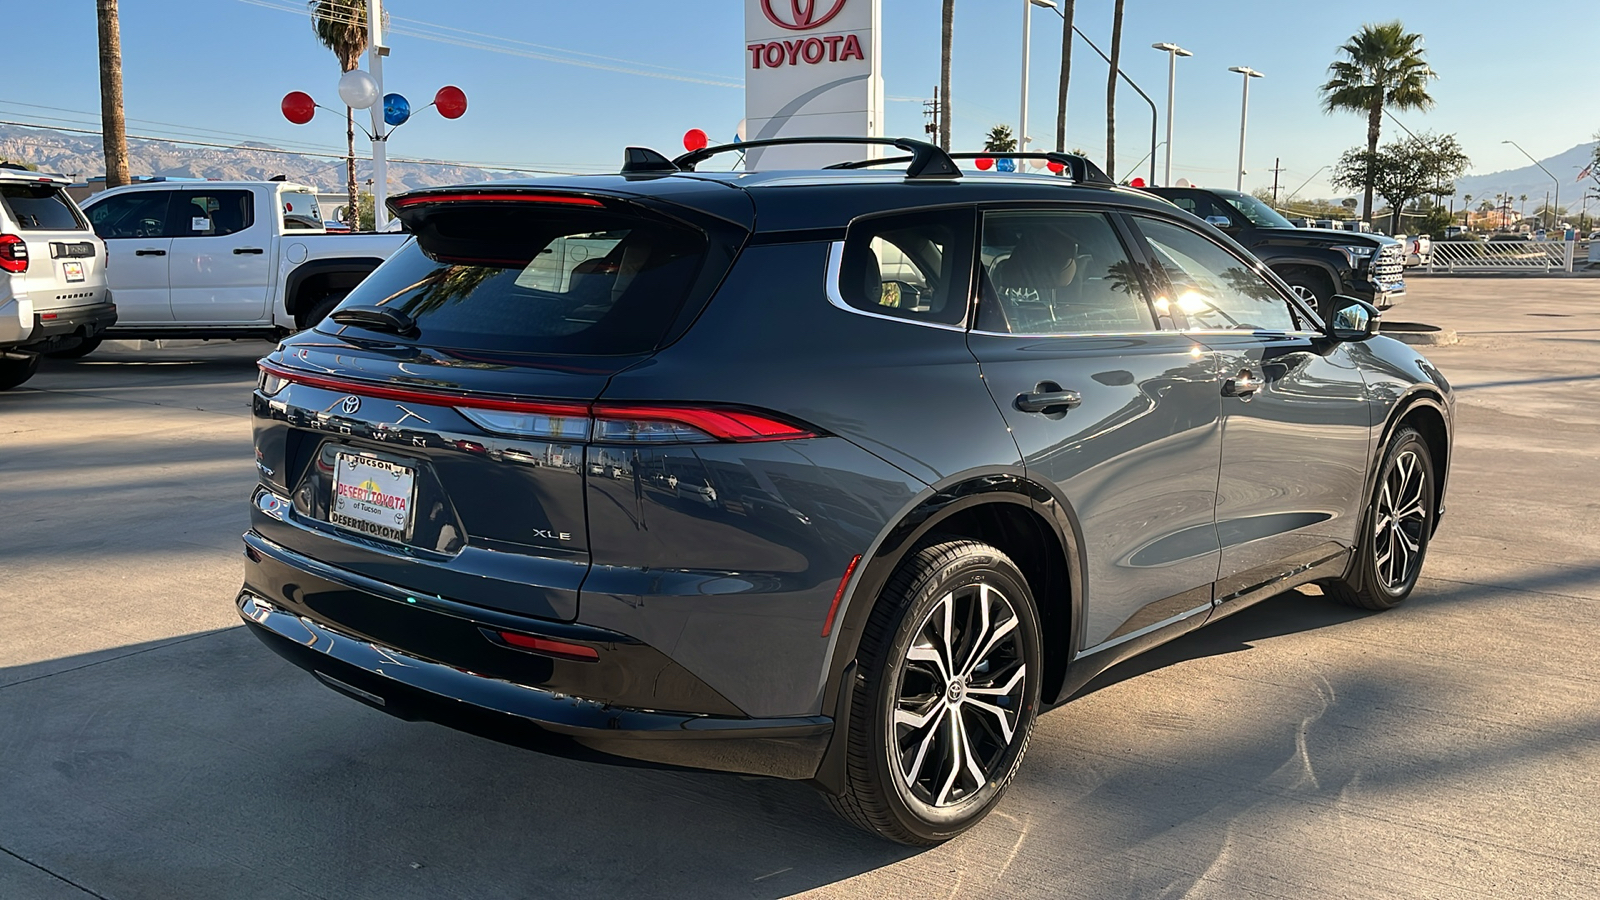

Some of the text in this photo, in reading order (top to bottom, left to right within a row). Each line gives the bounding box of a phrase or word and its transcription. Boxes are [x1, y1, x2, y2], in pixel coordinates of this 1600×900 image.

[747, 34, 865, 69] TOYOTA
[287, 415, 428, 448] CROWN
[354, 456, 392, 471] TUCSON
[338, 483, 406, 511] DESERT TOYOTA
[361, 503, 382, 515] Tucson
[332, 513, 401, 541] DESERT TOYOTA
[532, 528, 572, 541] XLE
